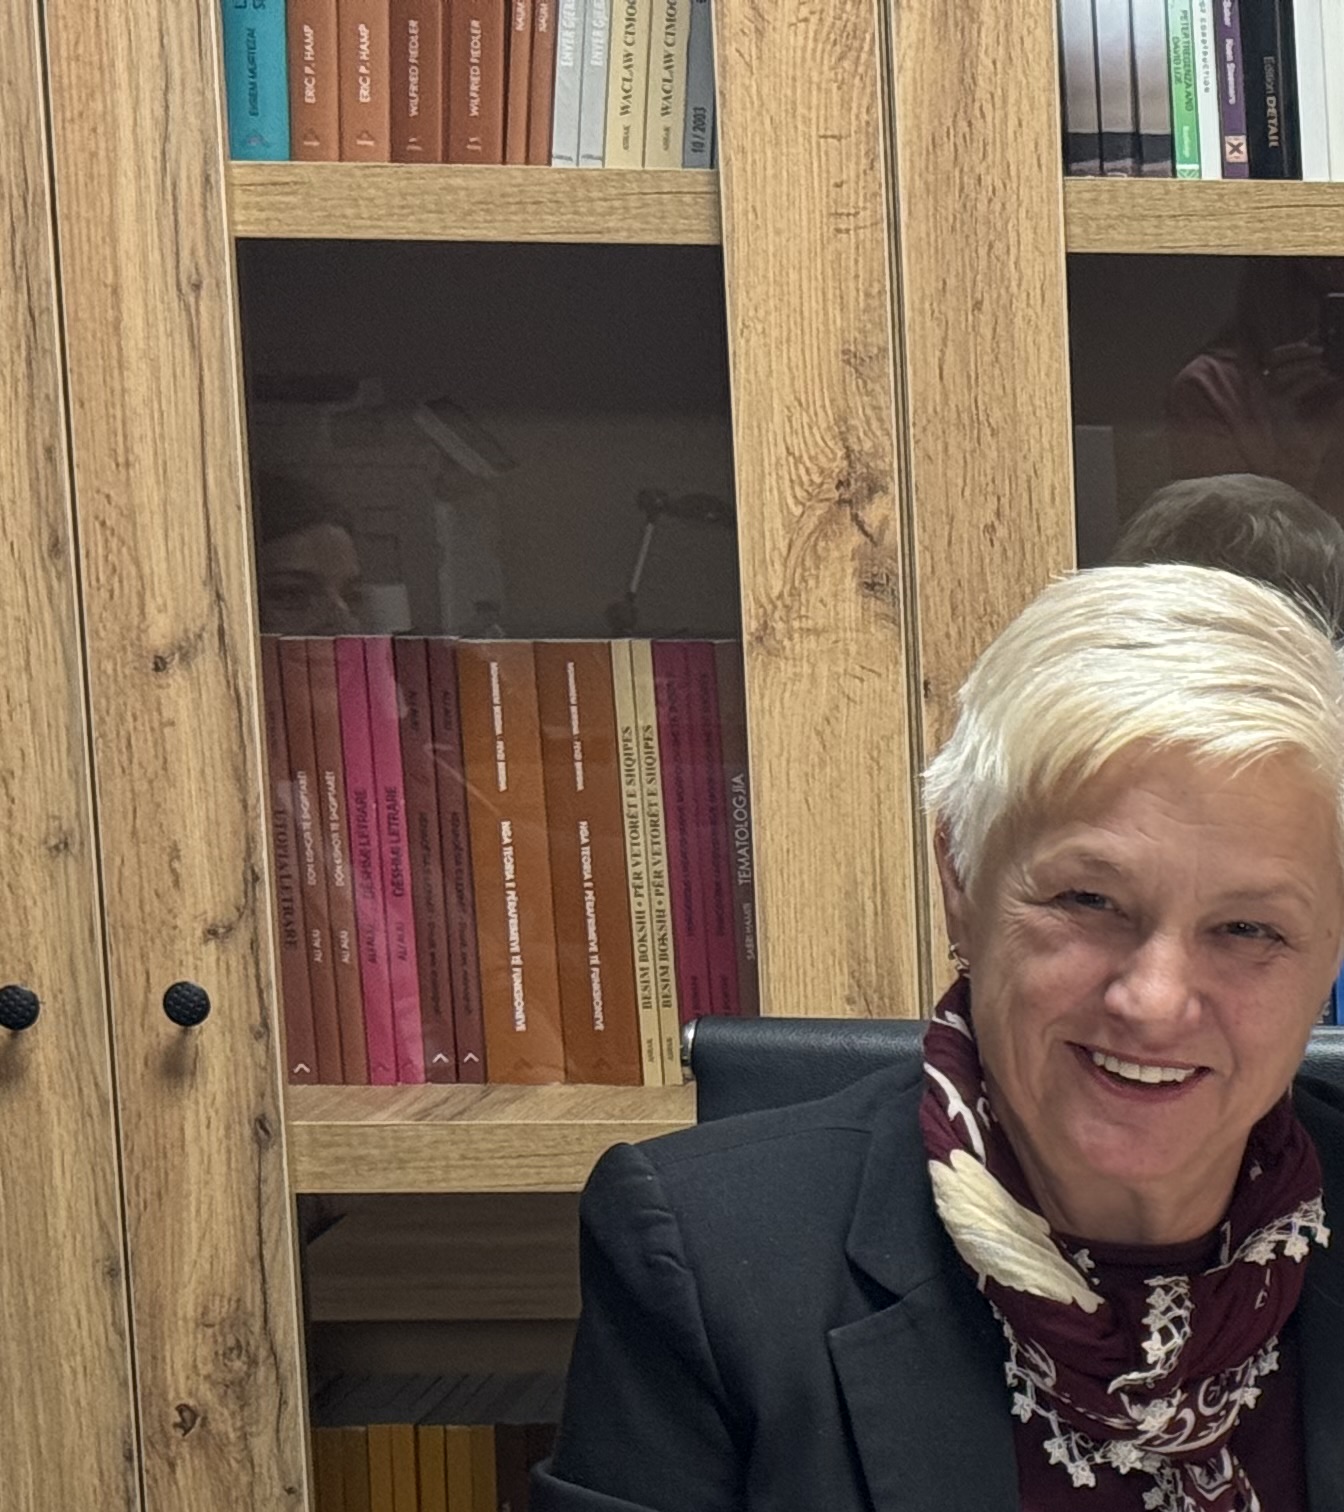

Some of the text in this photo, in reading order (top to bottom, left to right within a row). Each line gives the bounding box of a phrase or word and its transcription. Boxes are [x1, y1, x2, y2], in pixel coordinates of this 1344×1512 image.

[303, 24, 315, 61] HAMP
[358, 22, 370, 60] HAMP
[620, 726, 636, 787] SHQIPES
[641, 725, 658, 786] SHQIPES
[730, 773, 752, 887] TEMATOLOGJIA
[631, 871, 645, 899] PËR
[635, 909, 650, 963] BOKSHI
[655, 908, 670, 963] BOKSHI
[639, 964, 654, 1011] BESIM
[658, 964, 674, 1009] BESIM
